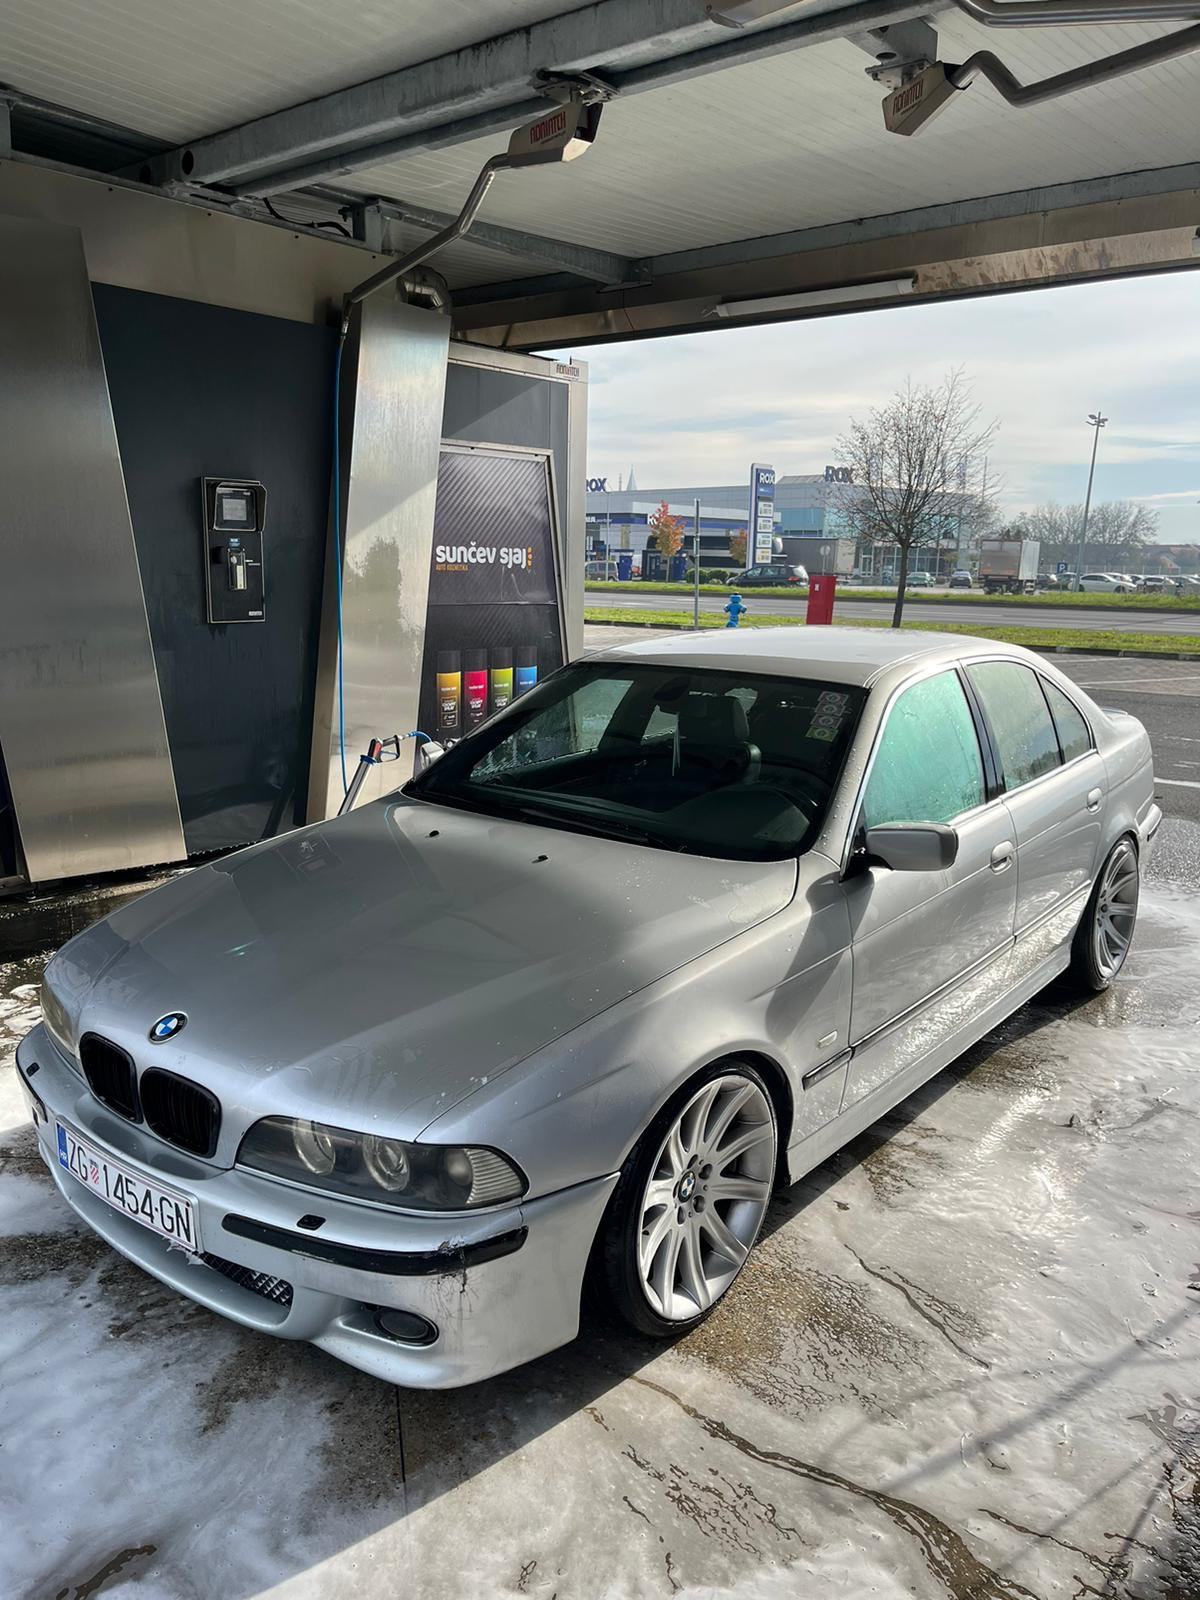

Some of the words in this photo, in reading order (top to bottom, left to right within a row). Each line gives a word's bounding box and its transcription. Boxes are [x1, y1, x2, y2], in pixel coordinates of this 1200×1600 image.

[436, 541, 496, 563] sunčev
[500, 547, 526, 568] sjaj
[68, 1137, 88, 1181] ZG
